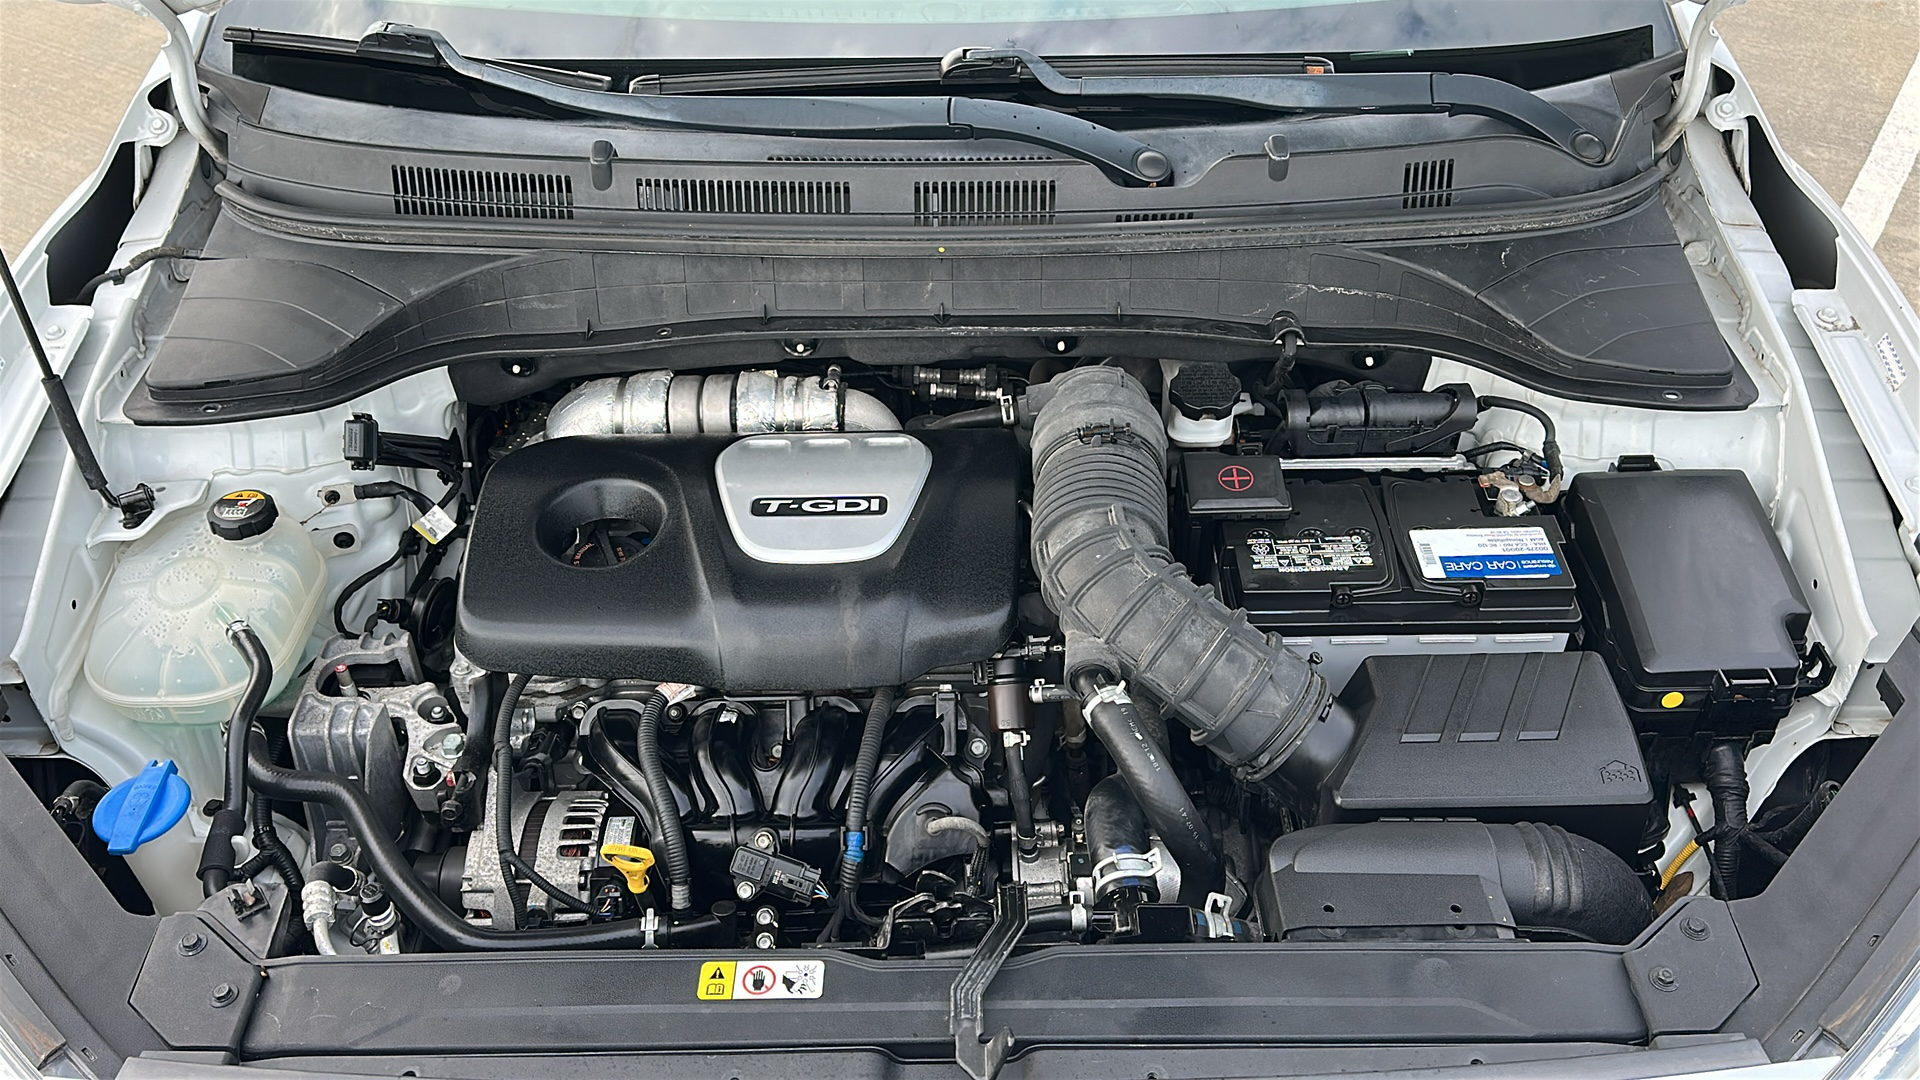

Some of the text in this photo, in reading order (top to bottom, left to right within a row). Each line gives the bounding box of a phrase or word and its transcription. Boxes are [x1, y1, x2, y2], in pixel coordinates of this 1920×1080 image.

[759, 498, 880, 513] T-GDI
[1444, 560, 1517, 572] CAR CARE
